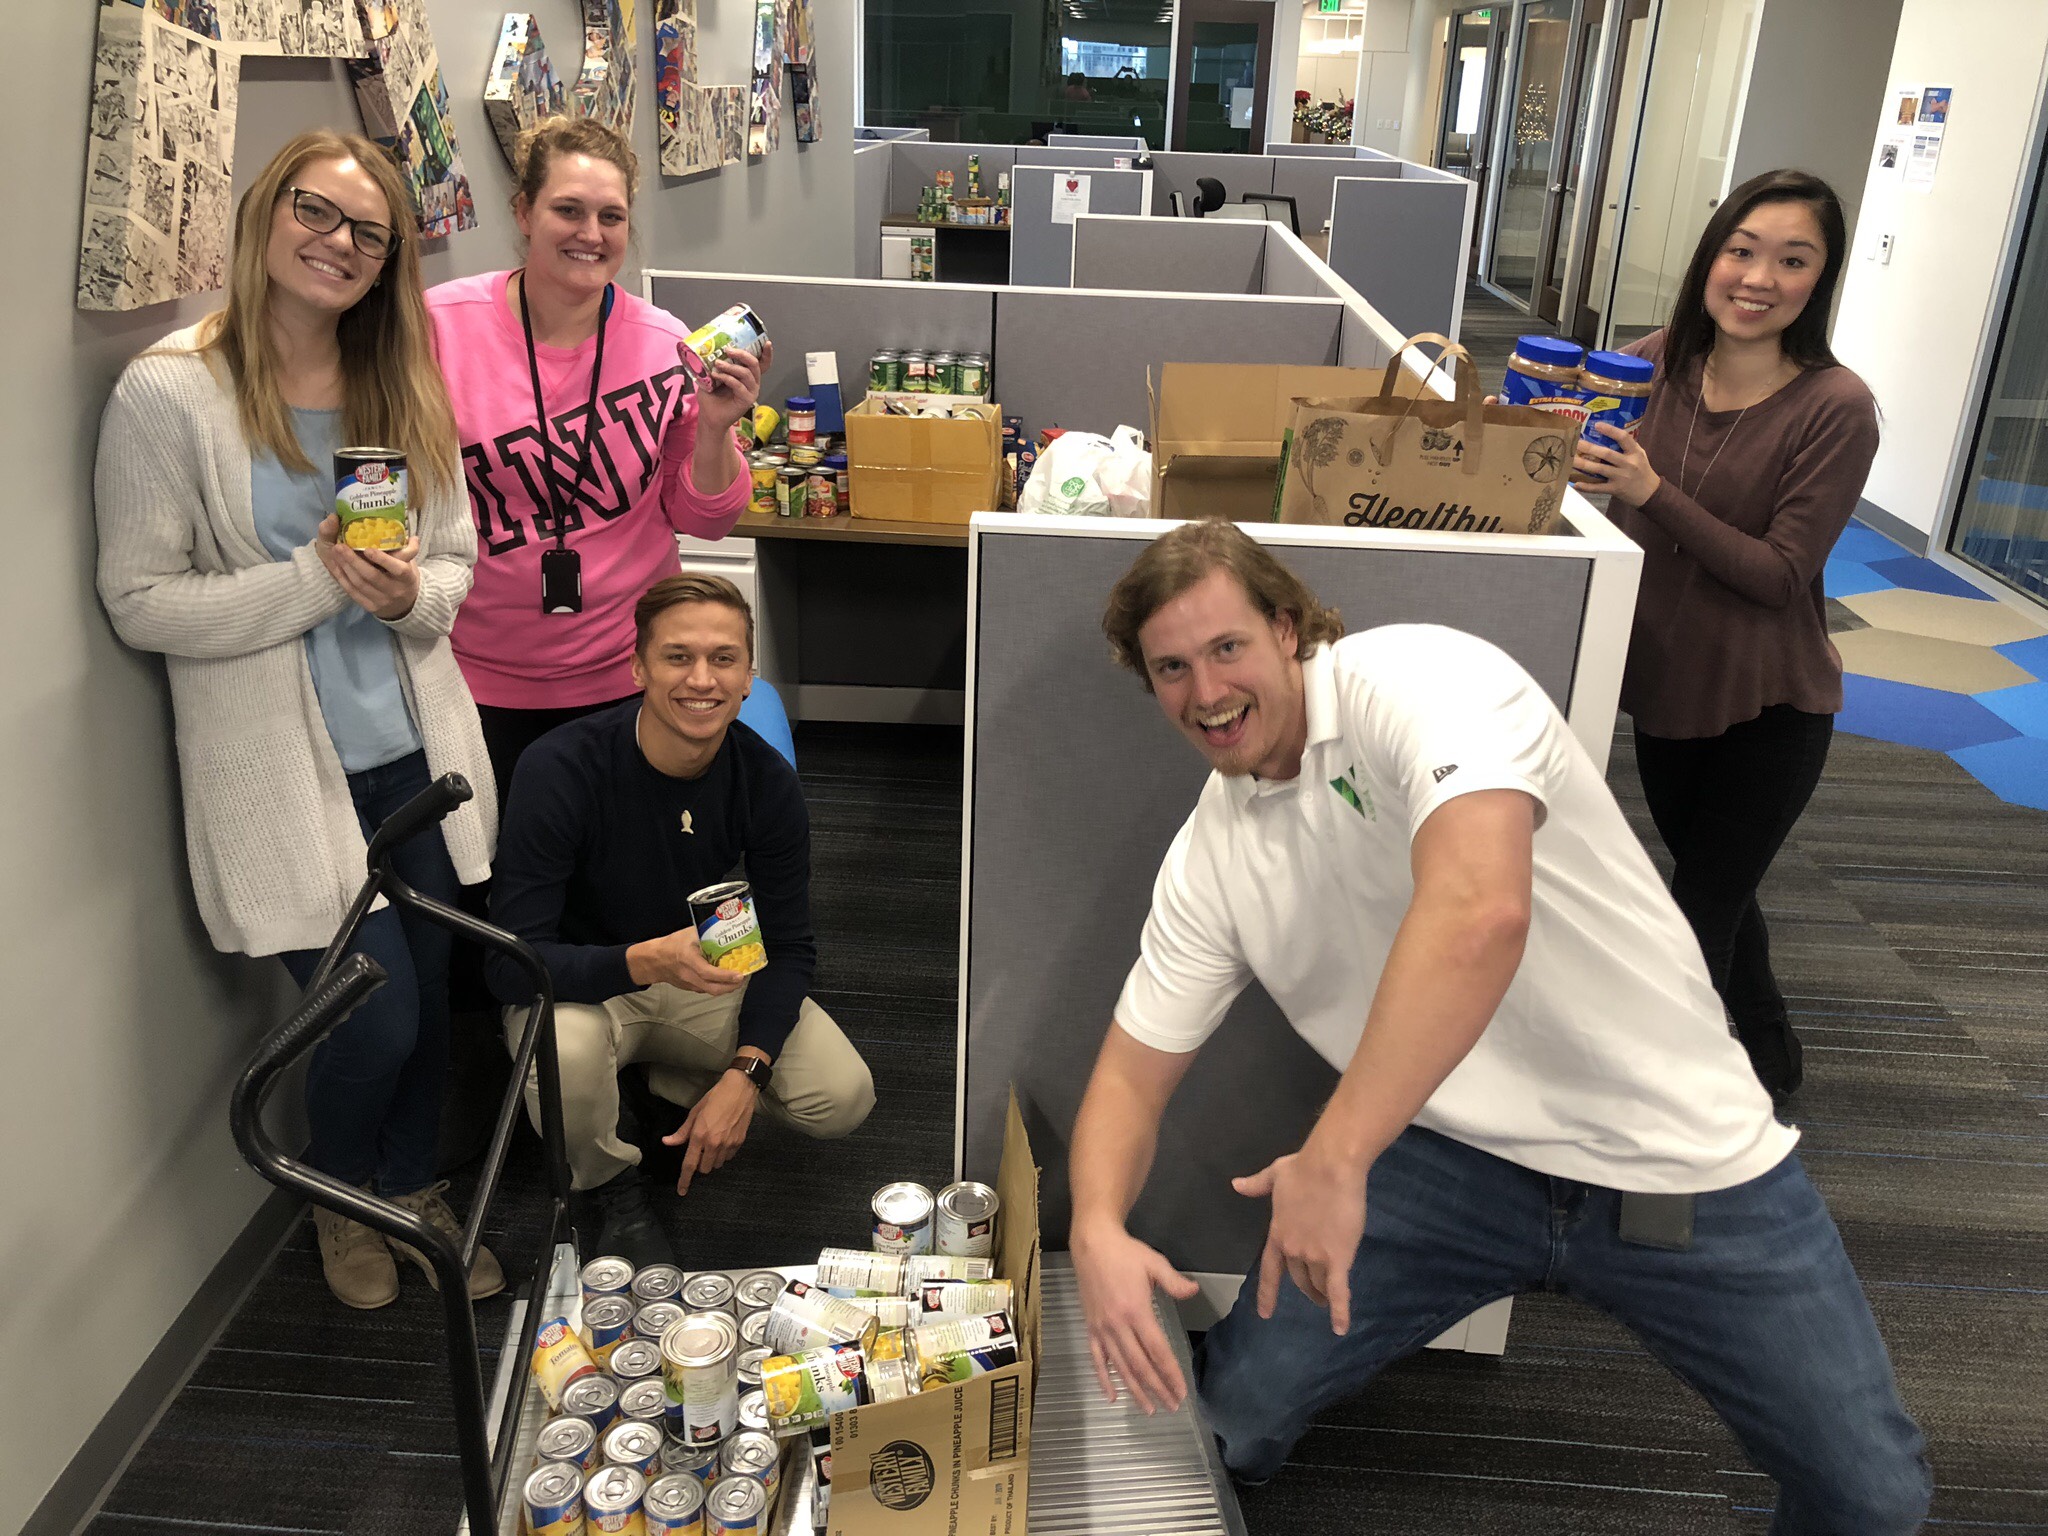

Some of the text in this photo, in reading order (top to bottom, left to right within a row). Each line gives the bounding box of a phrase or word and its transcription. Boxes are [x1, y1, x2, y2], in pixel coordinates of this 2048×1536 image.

[1529, 397, 1554, 405] EXTRA
[1553, 397, 1584, 405] CRUNCHY
[351, 496, 396, 511] Chunks
[1344, 492, 1503, 532] Healthy
[718, 924, 752, 946] Chunks
[549, 1343, 579, 1366] Tomato
[953, 1386, 963, 1412] JUICE
[836, 1411, 844, 1434] 15400
[849, 1416, 858, 1438] 01303
[836, 1435, 844, 1445] 00
[952, 1413, 963, 1458] PINEAPPLE
[952, 1459, 961, 1468] IN
[869, 1450, 906, 1506] WESTERN
[898, 1455, 930, 1496] FAMILY
[950, 1469, 961, 1500] CHUNKS
[1007, 1473, 1015, 1501] THAILAND
